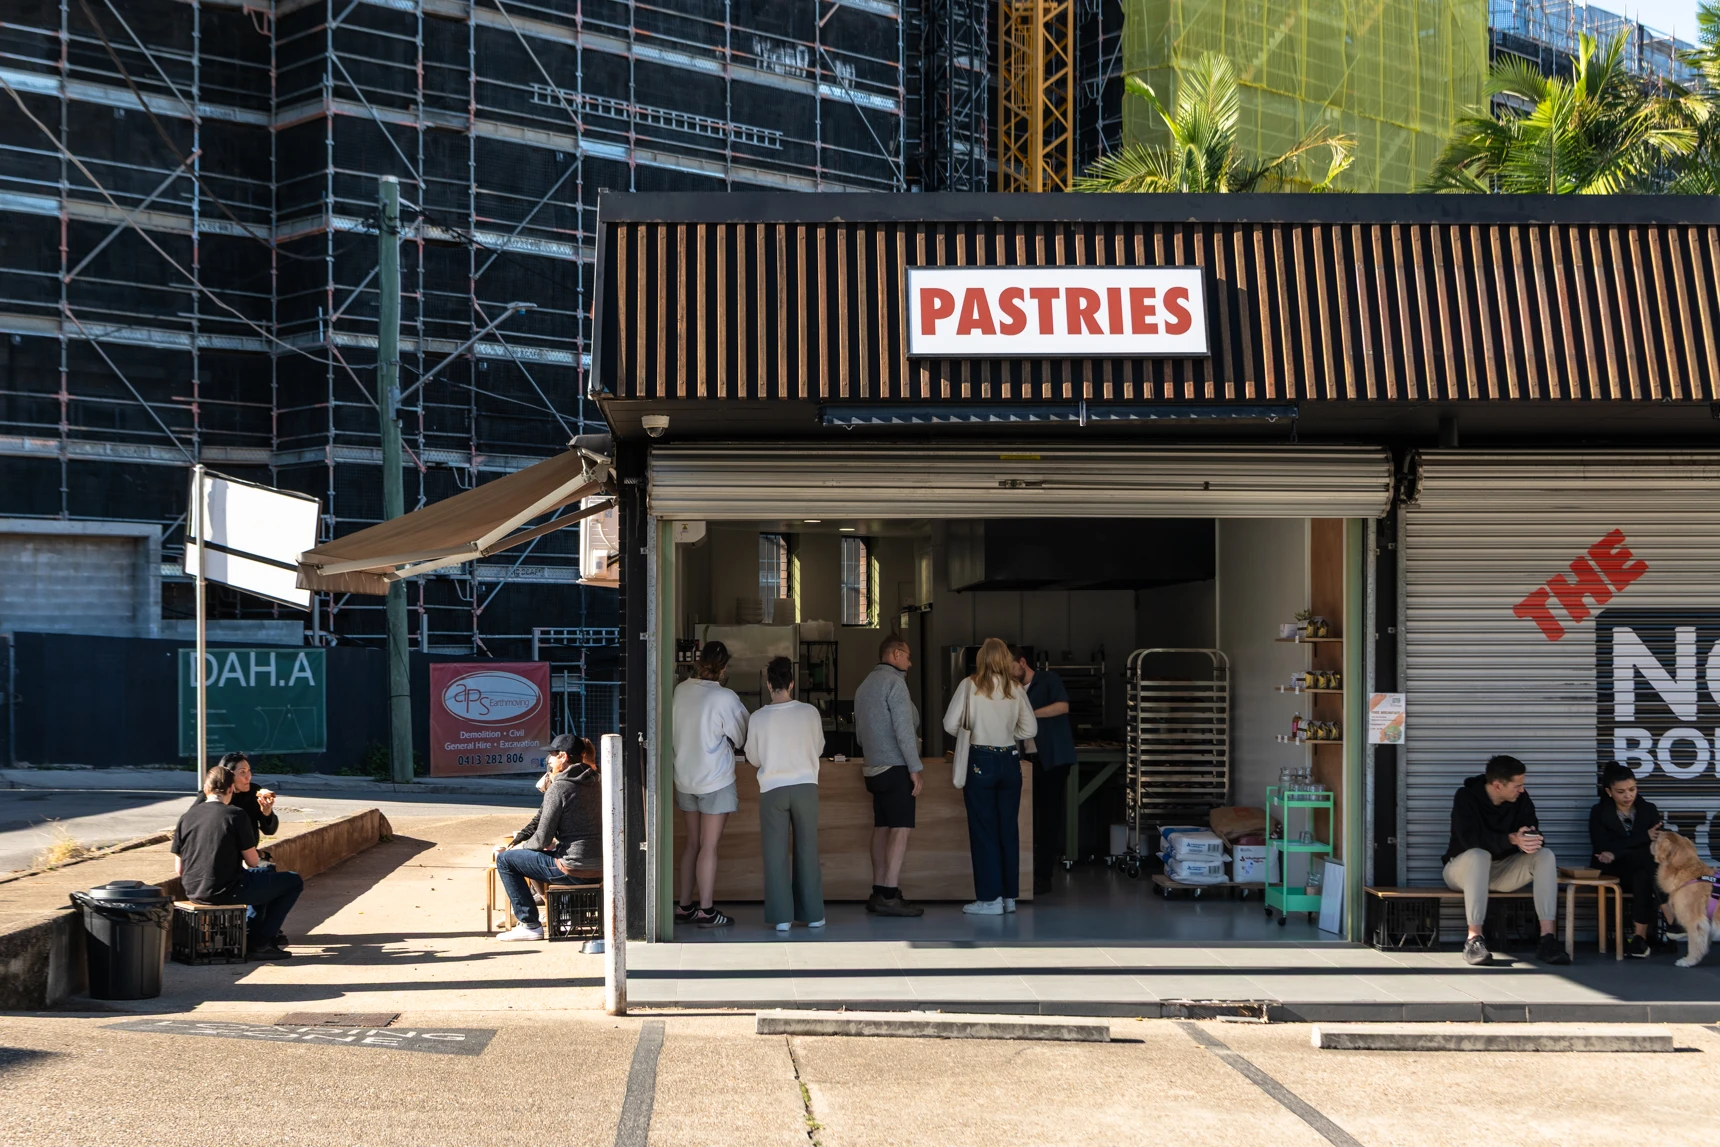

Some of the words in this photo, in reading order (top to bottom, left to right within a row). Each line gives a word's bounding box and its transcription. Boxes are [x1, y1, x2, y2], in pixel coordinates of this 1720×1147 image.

[919, 286, 1192, 336] PASTRIES
[1512, 528, 1649, 641] THE
[189, 651, 316, 688] DAH.A
[1611, 626, 1720, 721] N
[489, 698, 530, 708] Earthmoving
[444, 741, 474, 751] General
[475, 741, 492, 750] Hire
[499, 738, 540, 749] Excavation
[460, 730, 501, 739] Demolition
[509, 729, 525, 737] Civil
[457, 754, 481, 766] 0413
[485, 753, 503, 765] 282
[506, 752, 524, 764] 806
[1613, 727, 1720, 780] BO
[152, 1020, 466, 1041] LOADING
